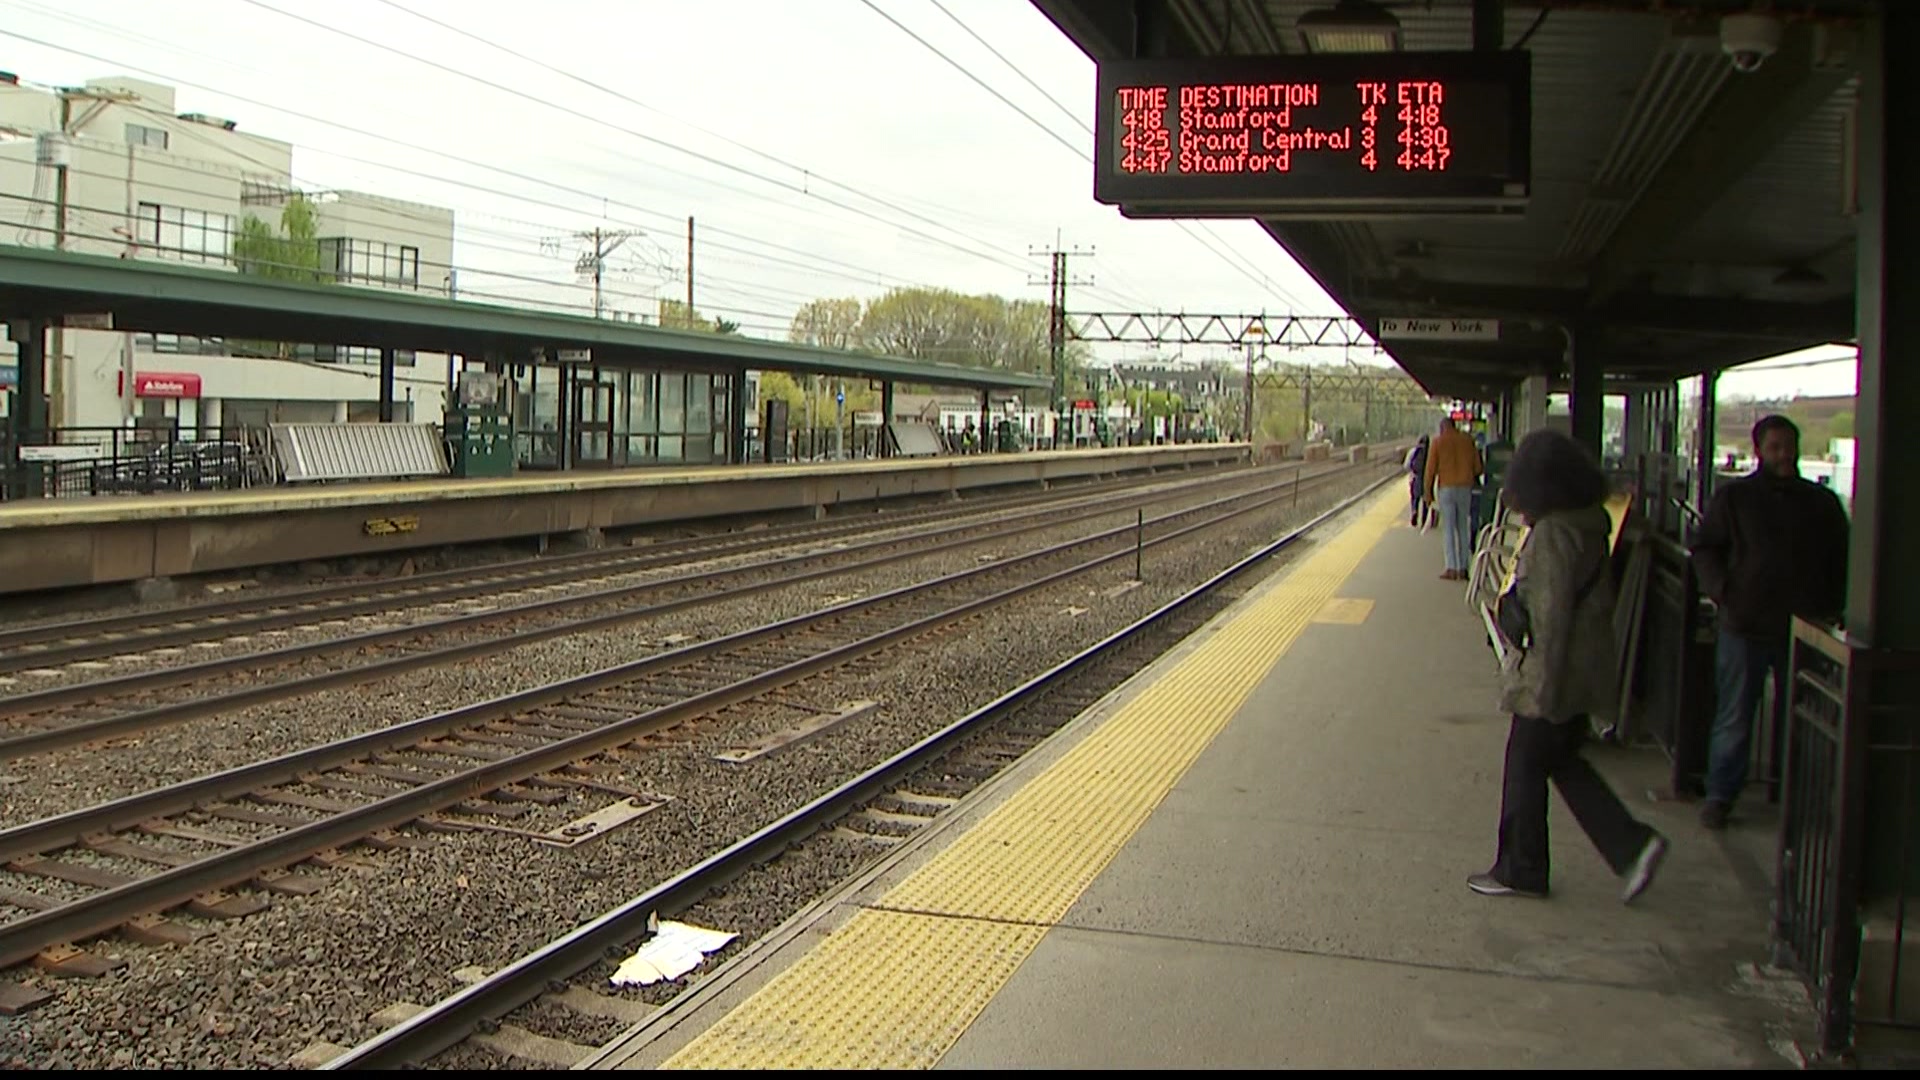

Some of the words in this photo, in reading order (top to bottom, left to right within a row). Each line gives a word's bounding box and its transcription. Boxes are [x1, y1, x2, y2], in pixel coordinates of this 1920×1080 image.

[1118, 87, 1168, 110] TIME
[1180, 84, 1318, 108] DESTINATION
[1356, 82, 1387, 105] TK
[1398, 82, 1442, 104] ETA
[1122, 109, 1162, 131] 4:18
[1180, 105, 1290, 130] Stamford
[1362, 104, 1378, 127] 4
[1398, 104, 1439, 126] 4:18
[1122, 130, 1169, 152] 4:25
[1180, 128, 1249, 151] Grand
[1263, 127, 1350, 150] Central
[1361, 127, 1375, 149] 3
[1398, 126, 1448, 149] 4:30
[1121, 151, 1171, 173] 4:47
[1179, 149, 1289, 173] Stamford
[1361, 148, 1377, 171] 4
[1397, 148, 1450, 171] 4:47
[1382, 320, 1398, 332] To
[1406, 320, 1441, 332] New
[1451, 320, 1483, 332] York
